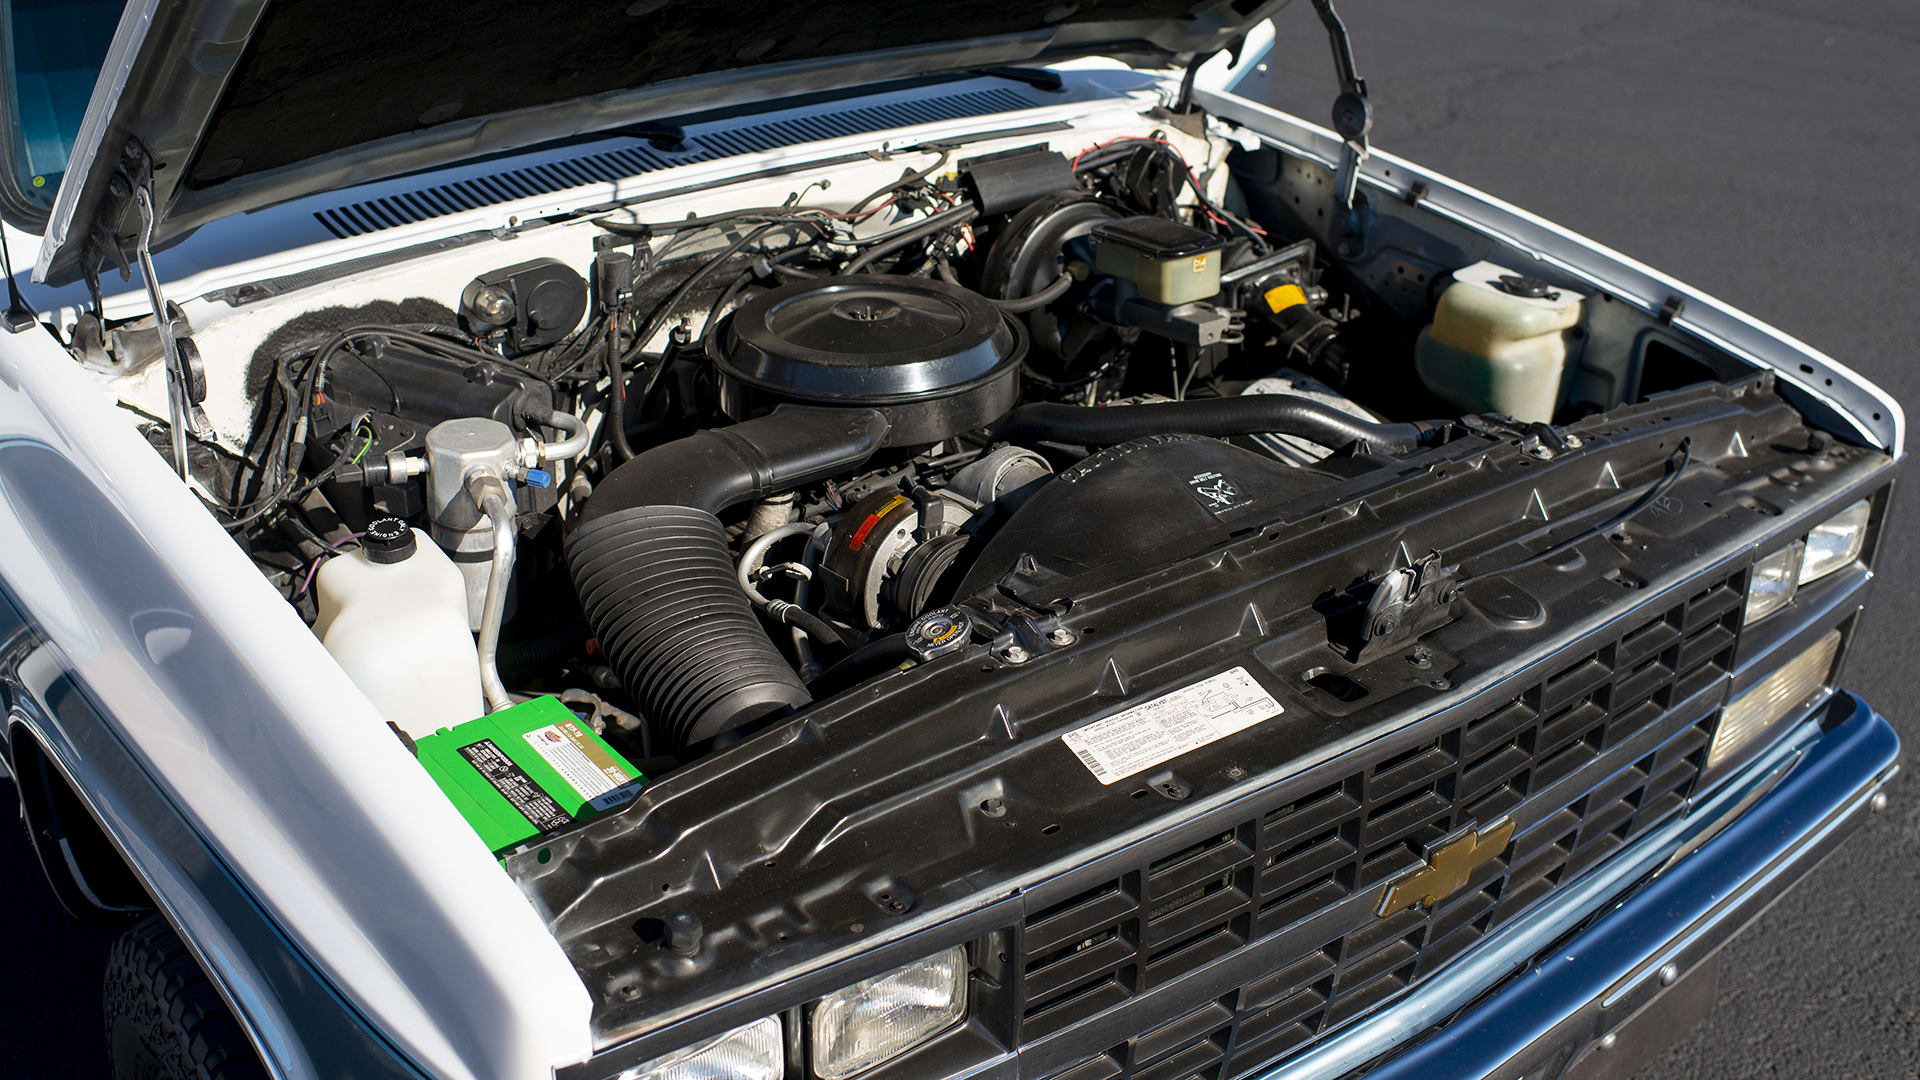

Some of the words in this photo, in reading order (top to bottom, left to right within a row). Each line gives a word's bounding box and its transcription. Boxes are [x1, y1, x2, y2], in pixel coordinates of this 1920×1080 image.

[368, 517, 399, 531] COOLANT
[921, 608, 950, 621] COOLANT
[927, 639, 946, 648] NEVER
